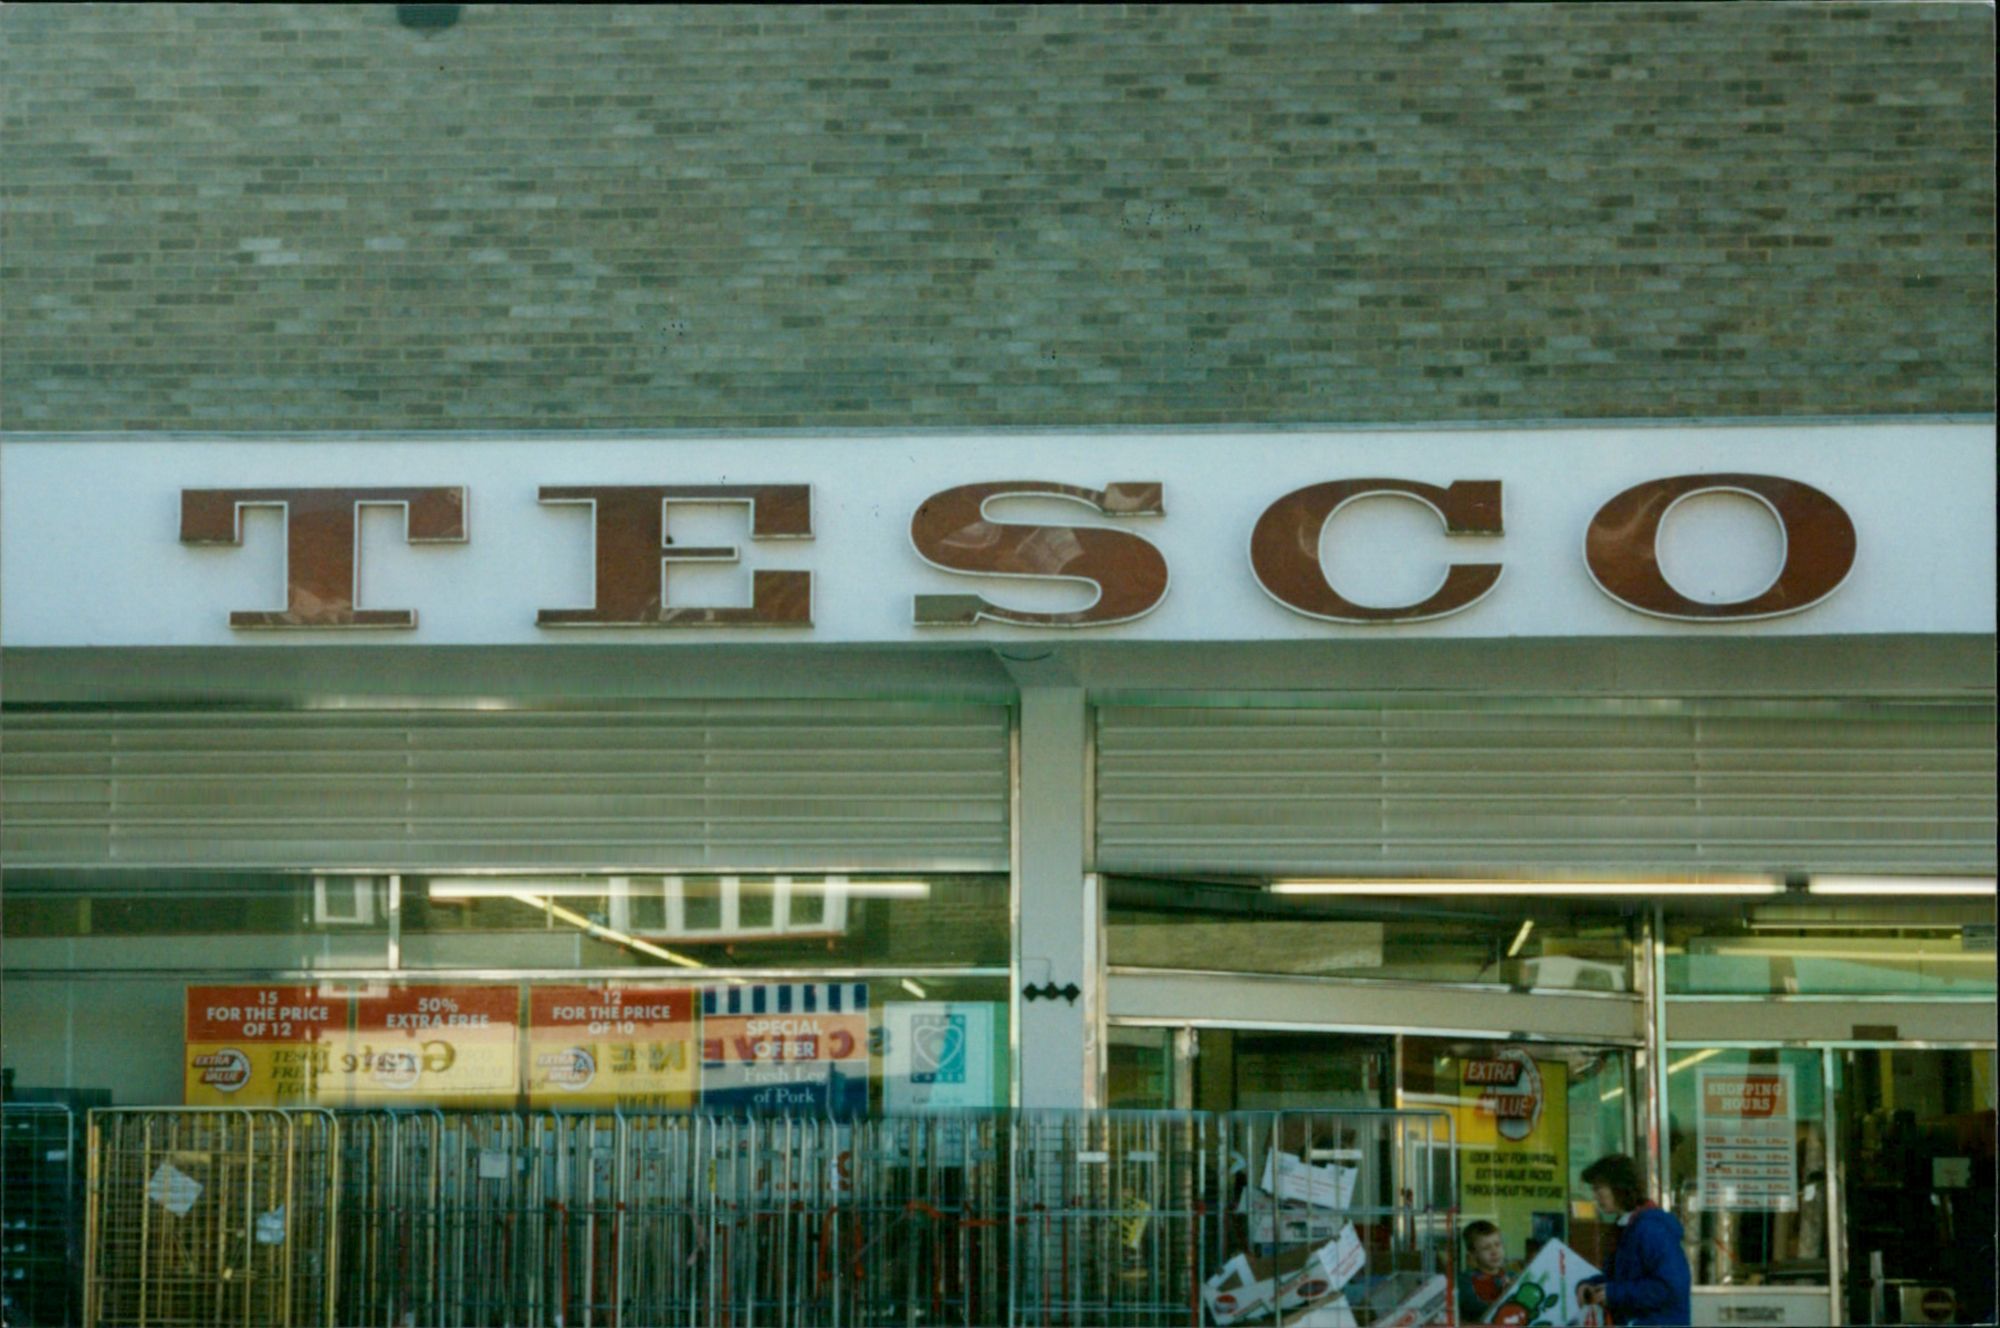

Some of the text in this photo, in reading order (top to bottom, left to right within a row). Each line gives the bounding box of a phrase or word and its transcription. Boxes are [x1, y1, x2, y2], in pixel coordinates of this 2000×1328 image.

[180, 472, 1857, 628] TESCO
[258, 991, 278, 1005] 15
[418, 998, 459, 1013] 50%
[603, 991, 622, 1005] 12
[206, 1006, 329, 1021] FOR THE PRICE
[552, 1005, 671, 1021] FOR THE PRICE
[386, 1014, 489, 1029] EXTRA FREE
[587, 1021, 635, 1035] OF 10
[746, 1019, 822, 1036] SPECIAL
[242, 1022, 292, 1037] OF 12
[753, 1041, 816, 1058] OFFER
[194, 1055, 231, 1066] EXTRA
[203, 1071, 240, 1082] VALUE
[743, 1066, 828, 1088] Fresh Leg
[1467, 1061, 1516, 1081] EXTRA
[753, 1087, 815, 1103] of Pork
[1707, 1082, 1783, 1097] SHOPPING
[1721, 1097, 1771, 1111] HOURS
